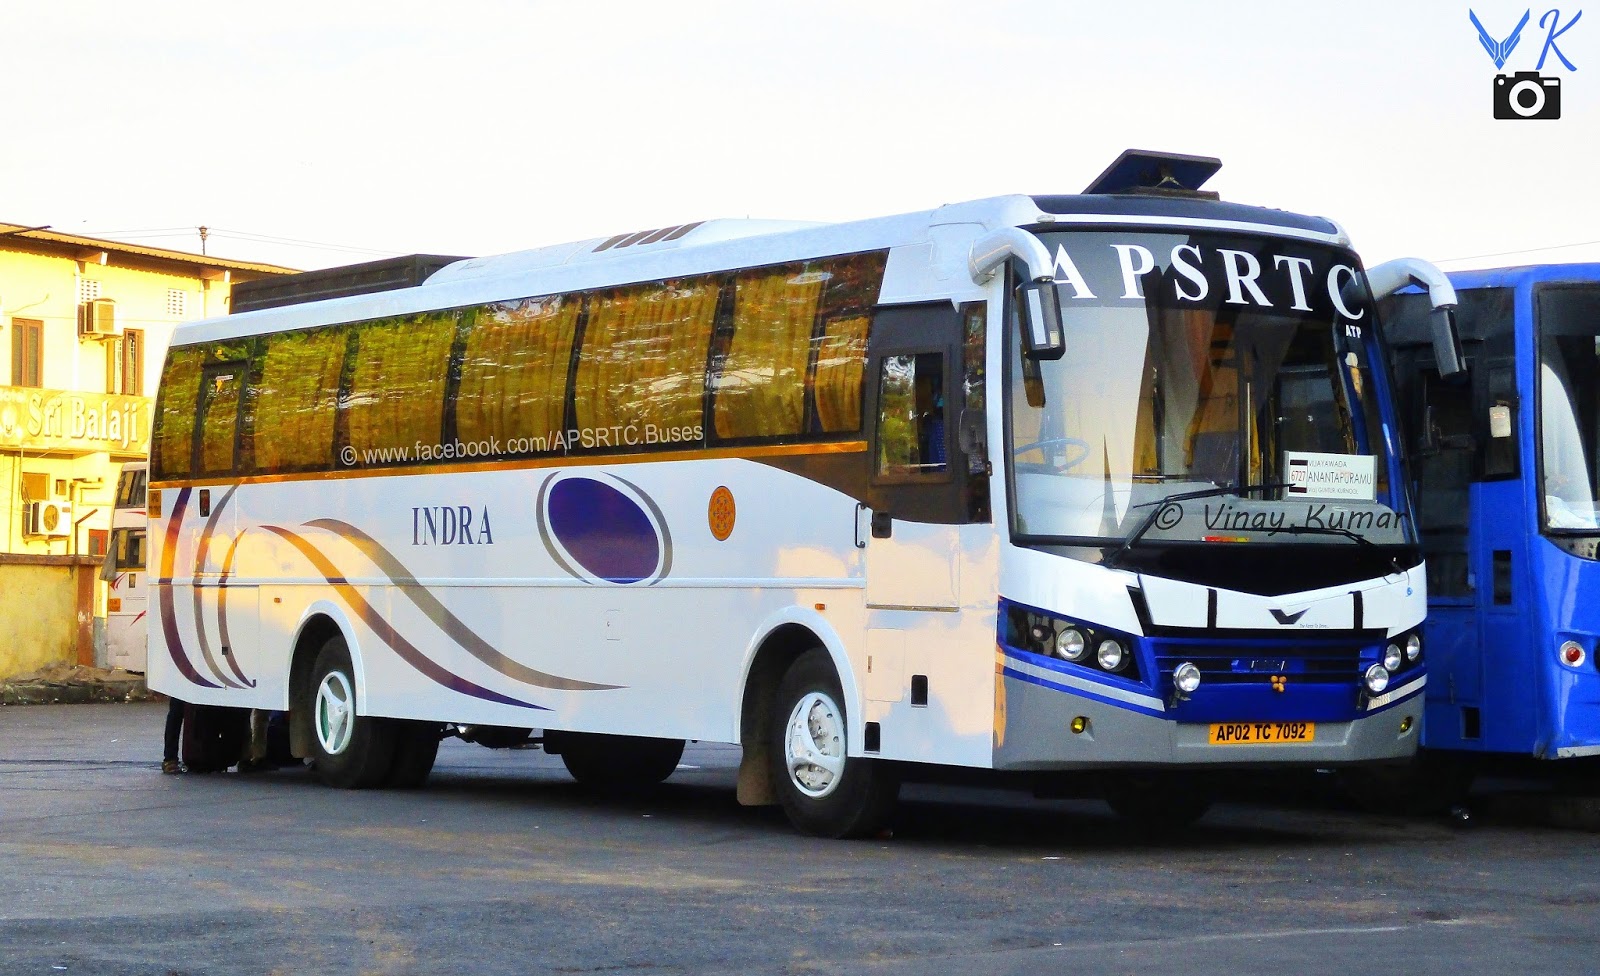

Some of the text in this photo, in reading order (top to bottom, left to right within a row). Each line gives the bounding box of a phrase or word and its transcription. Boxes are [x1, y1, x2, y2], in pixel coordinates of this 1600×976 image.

[1346, 324, 1361, 338] ATP
[27, 392, 62, 437] Sri
[70, 396, 138, 449] Balaji
[1308, 471, 1372, 485] ANANTAPURAMU
[411, 504, 493, 546] INDRA
[1216, 723, 1306, 741] AP02 TC 7092
